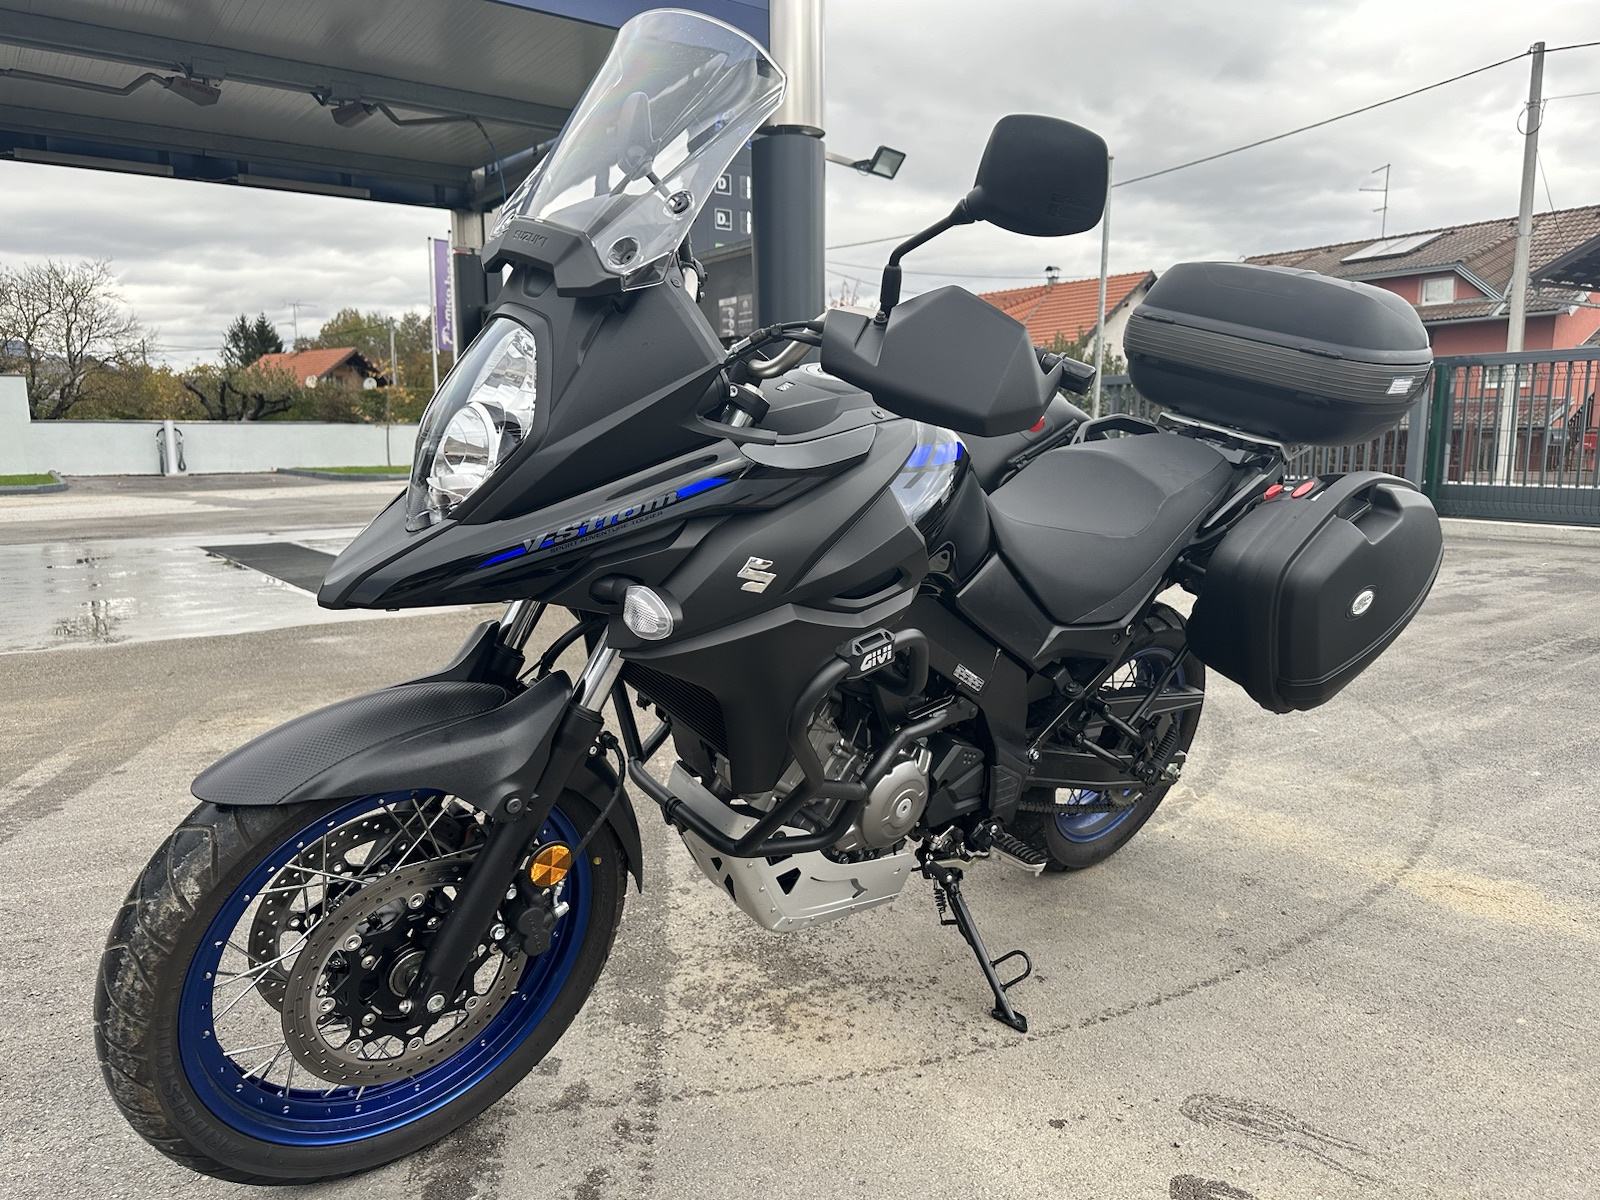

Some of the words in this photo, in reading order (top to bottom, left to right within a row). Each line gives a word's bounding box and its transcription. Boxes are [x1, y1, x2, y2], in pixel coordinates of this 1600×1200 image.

[550, 541, 579, 553] SPORT
[579, 524, 629, 542] ADVENTURE
[632, 512, 663, 524] TOURER
[860, 644, 892, 672] GIVI
